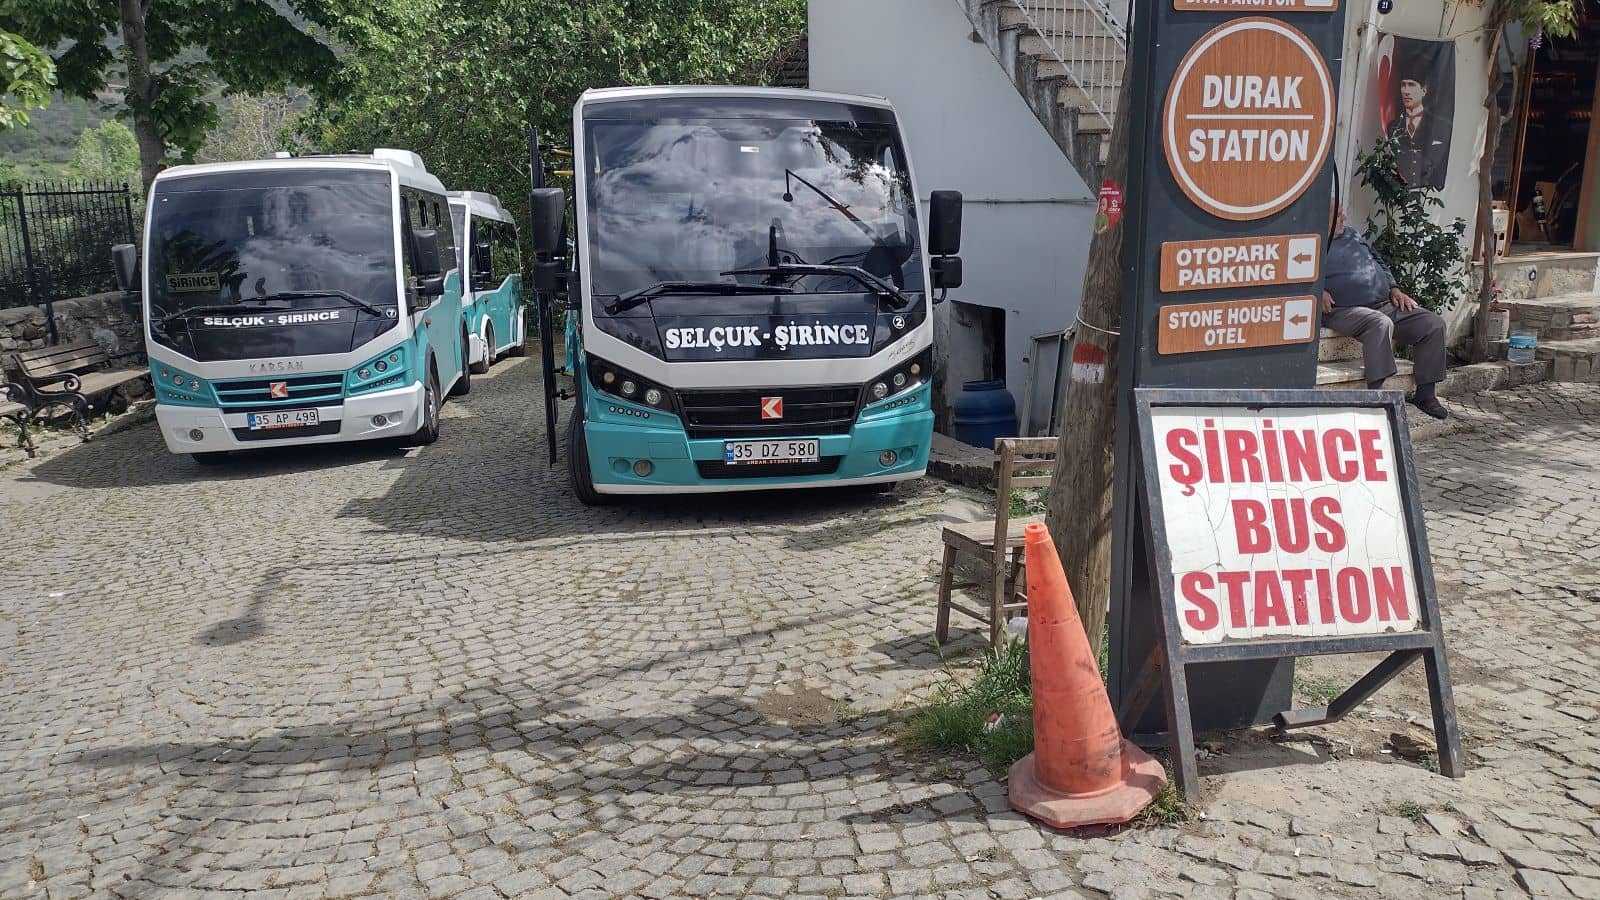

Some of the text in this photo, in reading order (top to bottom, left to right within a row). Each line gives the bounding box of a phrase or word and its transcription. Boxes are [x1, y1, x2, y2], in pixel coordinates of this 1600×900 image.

[1202, 75, 1304, 109] DURAK
[1188, 129, 1310, 162] STATION
[1176, 243, 1280, 266] OTOPARK
[1178, 264, 1276, 286] PARKING
[203, 316, 265, 328] SELÇUK
[278, 311, 340, 325] ŞİRİNCE
[894, 316, 904, 327] 2
[1168, 305, 1281, 329] STONE HOUSE
[665, 326, 762, 352] SELÇUK
[775, 320, 870, 350] ŞİRİNCE
[1204, 328, 1246, 346] OTEL
[250, 361, 304, 374] KARSAN
[256, 411, 316, 425] 35 AP 499
[735, 442, 815, 458] 35 DZ 580
[1166, 418, 1388, 497] ŞİRİNCE
[1231, 496, 1347, 555] BUS
[1180, 566, 1410, 631] STATION
